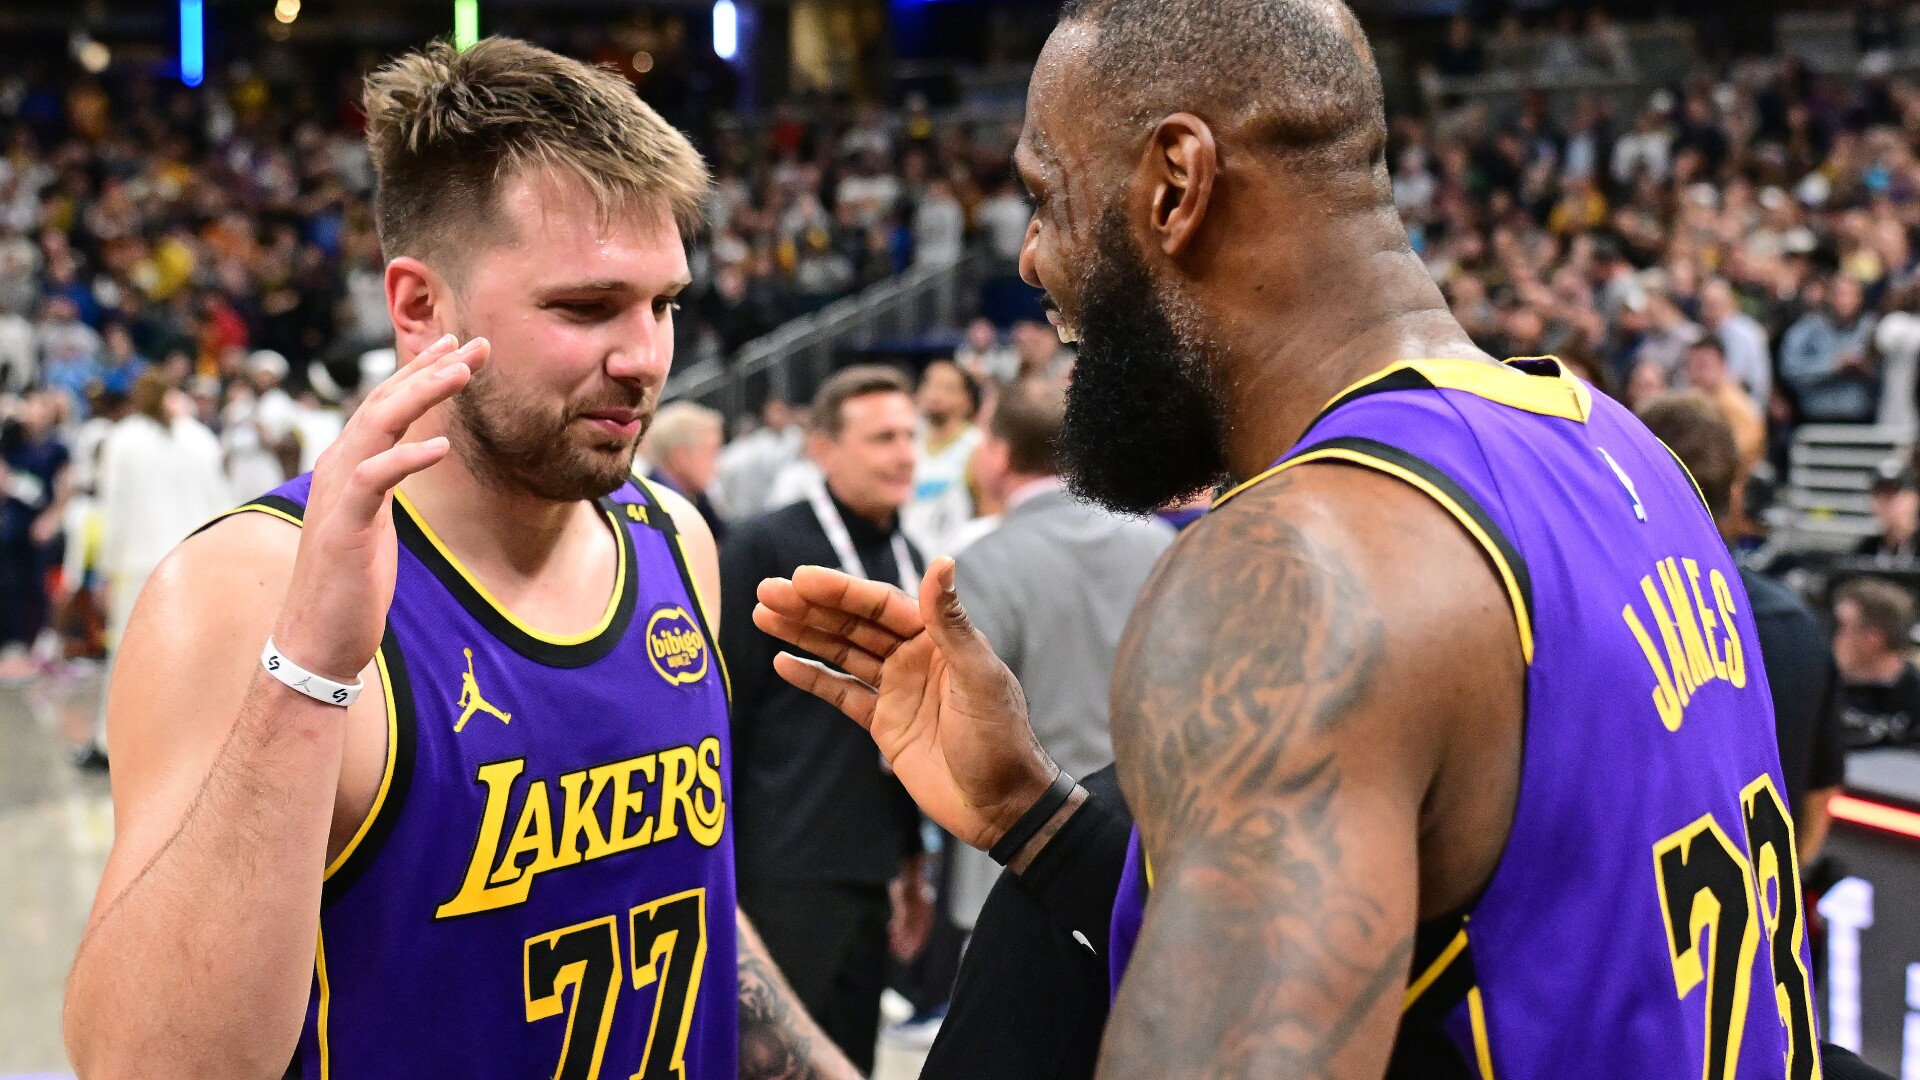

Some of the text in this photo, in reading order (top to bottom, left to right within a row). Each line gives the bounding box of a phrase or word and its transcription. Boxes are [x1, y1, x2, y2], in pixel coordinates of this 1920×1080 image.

[651, 627, 703, 659] bibigo
[1622, 556, 1746, 732] JAMES
[432, 735, 727, 921] LAKERS
[523, 887, 708, 1080] 77
